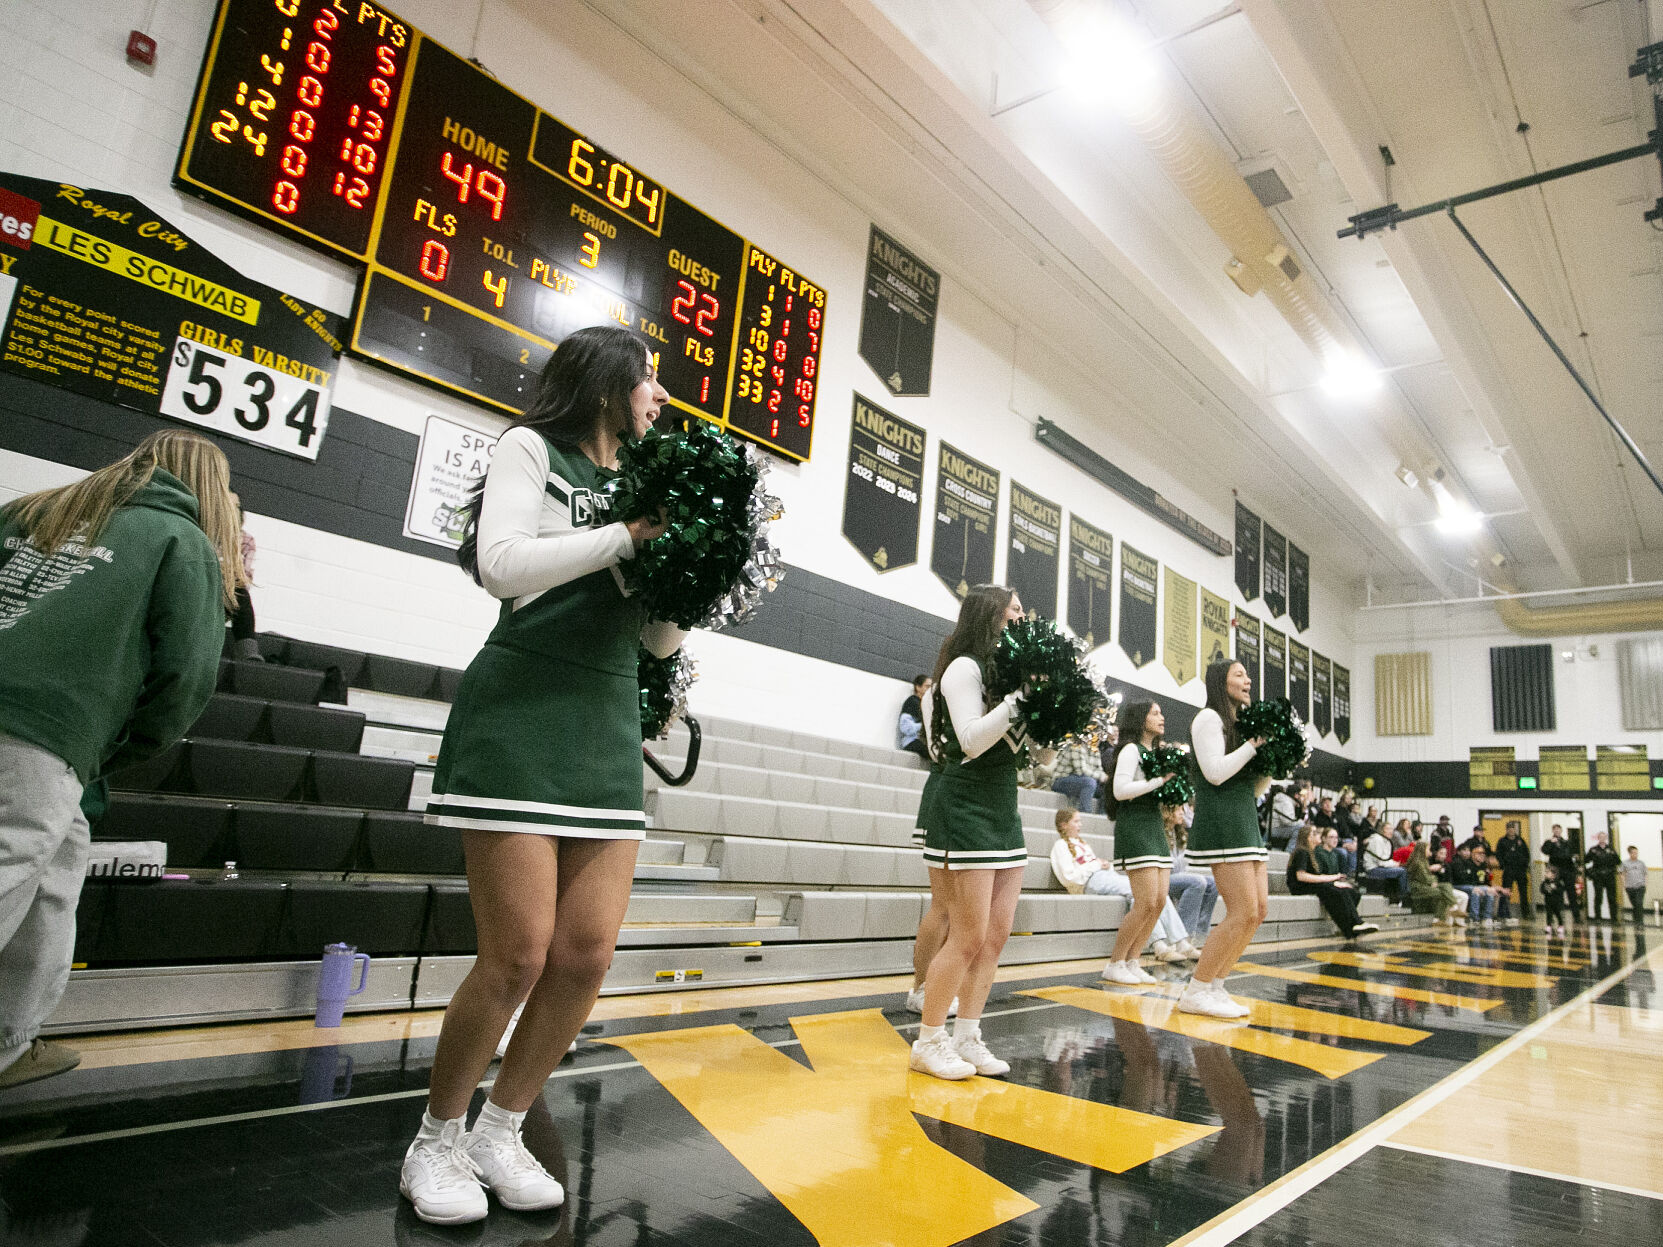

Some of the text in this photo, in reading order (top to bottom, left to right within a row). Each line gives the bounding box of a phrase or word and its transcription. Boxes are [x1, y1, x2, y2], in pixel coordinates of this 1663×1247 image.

[313, 8, 339, 40] 2
[377, 46, 396, 77] 5
[358, 2, 406, 48] PTS
[280, 27, 391, 108] 1 0 9
[261, 54, 384, 141] 4 0 13
[235, 81, 377, 175] 12 0 10
[441, 116, 510, 172] HOME
[211, 109, 370, 209] 24 0 12
[272, 181, 300, 214] 0
[441, 152, 507, 222] 49
[568, 138, 659, 223] 6:04
[0, 212, 33, 240] es
[56, 184, 188, 251] Royal City
[413, 198, 458, 237] FLS
[570, 203, 617, 239] PERIOD
[49, 225, 248, 317] LES SCHWAB
[419, 239, 449, 282] 0
[482, 236, 519, 268] T.O.L.
[578, 232, 601, 269] 3
[668, 249, 720, 291] GUEST
[872, 235, 936, 296] KNIGHTS
[482, 270, 507, 308] 4
[530, 258, 579, 296] PLYR
[750, 249, 824, 308] PLY FL PTS
[19, 297, 166, 353] by the Royal city varsity
[22, 285, 160, 338] For every point scored
[280, 294, 343, 352] LADY KNIGHTS
[312, 310, 326, 322] GO
[422, 305, 431, 322] 1
[672, 279, 720, 337] 22
[768, 284, 821, 330] 1 1 0
[13, 318, 49, 336] home
[101, 347, 134, 364] Royal
[137, 360, 159, 373] city
[16, 308, 82, 336] basketball
[85, 332, 121, 349] teams
[640, 317, 669, 344] T.O.L.
[760, 305, 818, 353] 3 1 7
[4, 352, 61, 375] program.
[9, 330, 160, 384] Les Schwabs will donate
[179, 320, 331, 387] GIRLS VARSITY
[519, 349, 530, 364] 2
[685, 337, 715, 367] FLS
[750, 327, 816, 378] 10 0 0
[48, 354, 90, 374] toward
[94, 369, 113, 381] the
[117, 377, 159, 395] athletic
[700, 376, 710, 404] 1
[741, 348, 813, 403] 32 4 10
[738, 374, 810, 428] 33 2 5
[771, 418, 779, 438] 1
[855, 402, 922, 454] KNIGHTS
[445, 450, 490, 474] IS A
[852, 462, 873, 482] 2022
[859, 453, 914, 488] STATE CHAMPIONS
[877, 444, 900, 465] DANCE
[941, 449, 997, 494] KNIGHTS
[945, 478, 965, 498] CROSS
[1013, 488, 1059, 528] KNIGHTS
[1071, 520, 1111, 557] KNIGHTS
[1122, 546, 1157, 579] KNIGHTS
[1203, 616, 1228, 637] KNIGHTS
[1204, 597, 1227, 623] ROYAL
